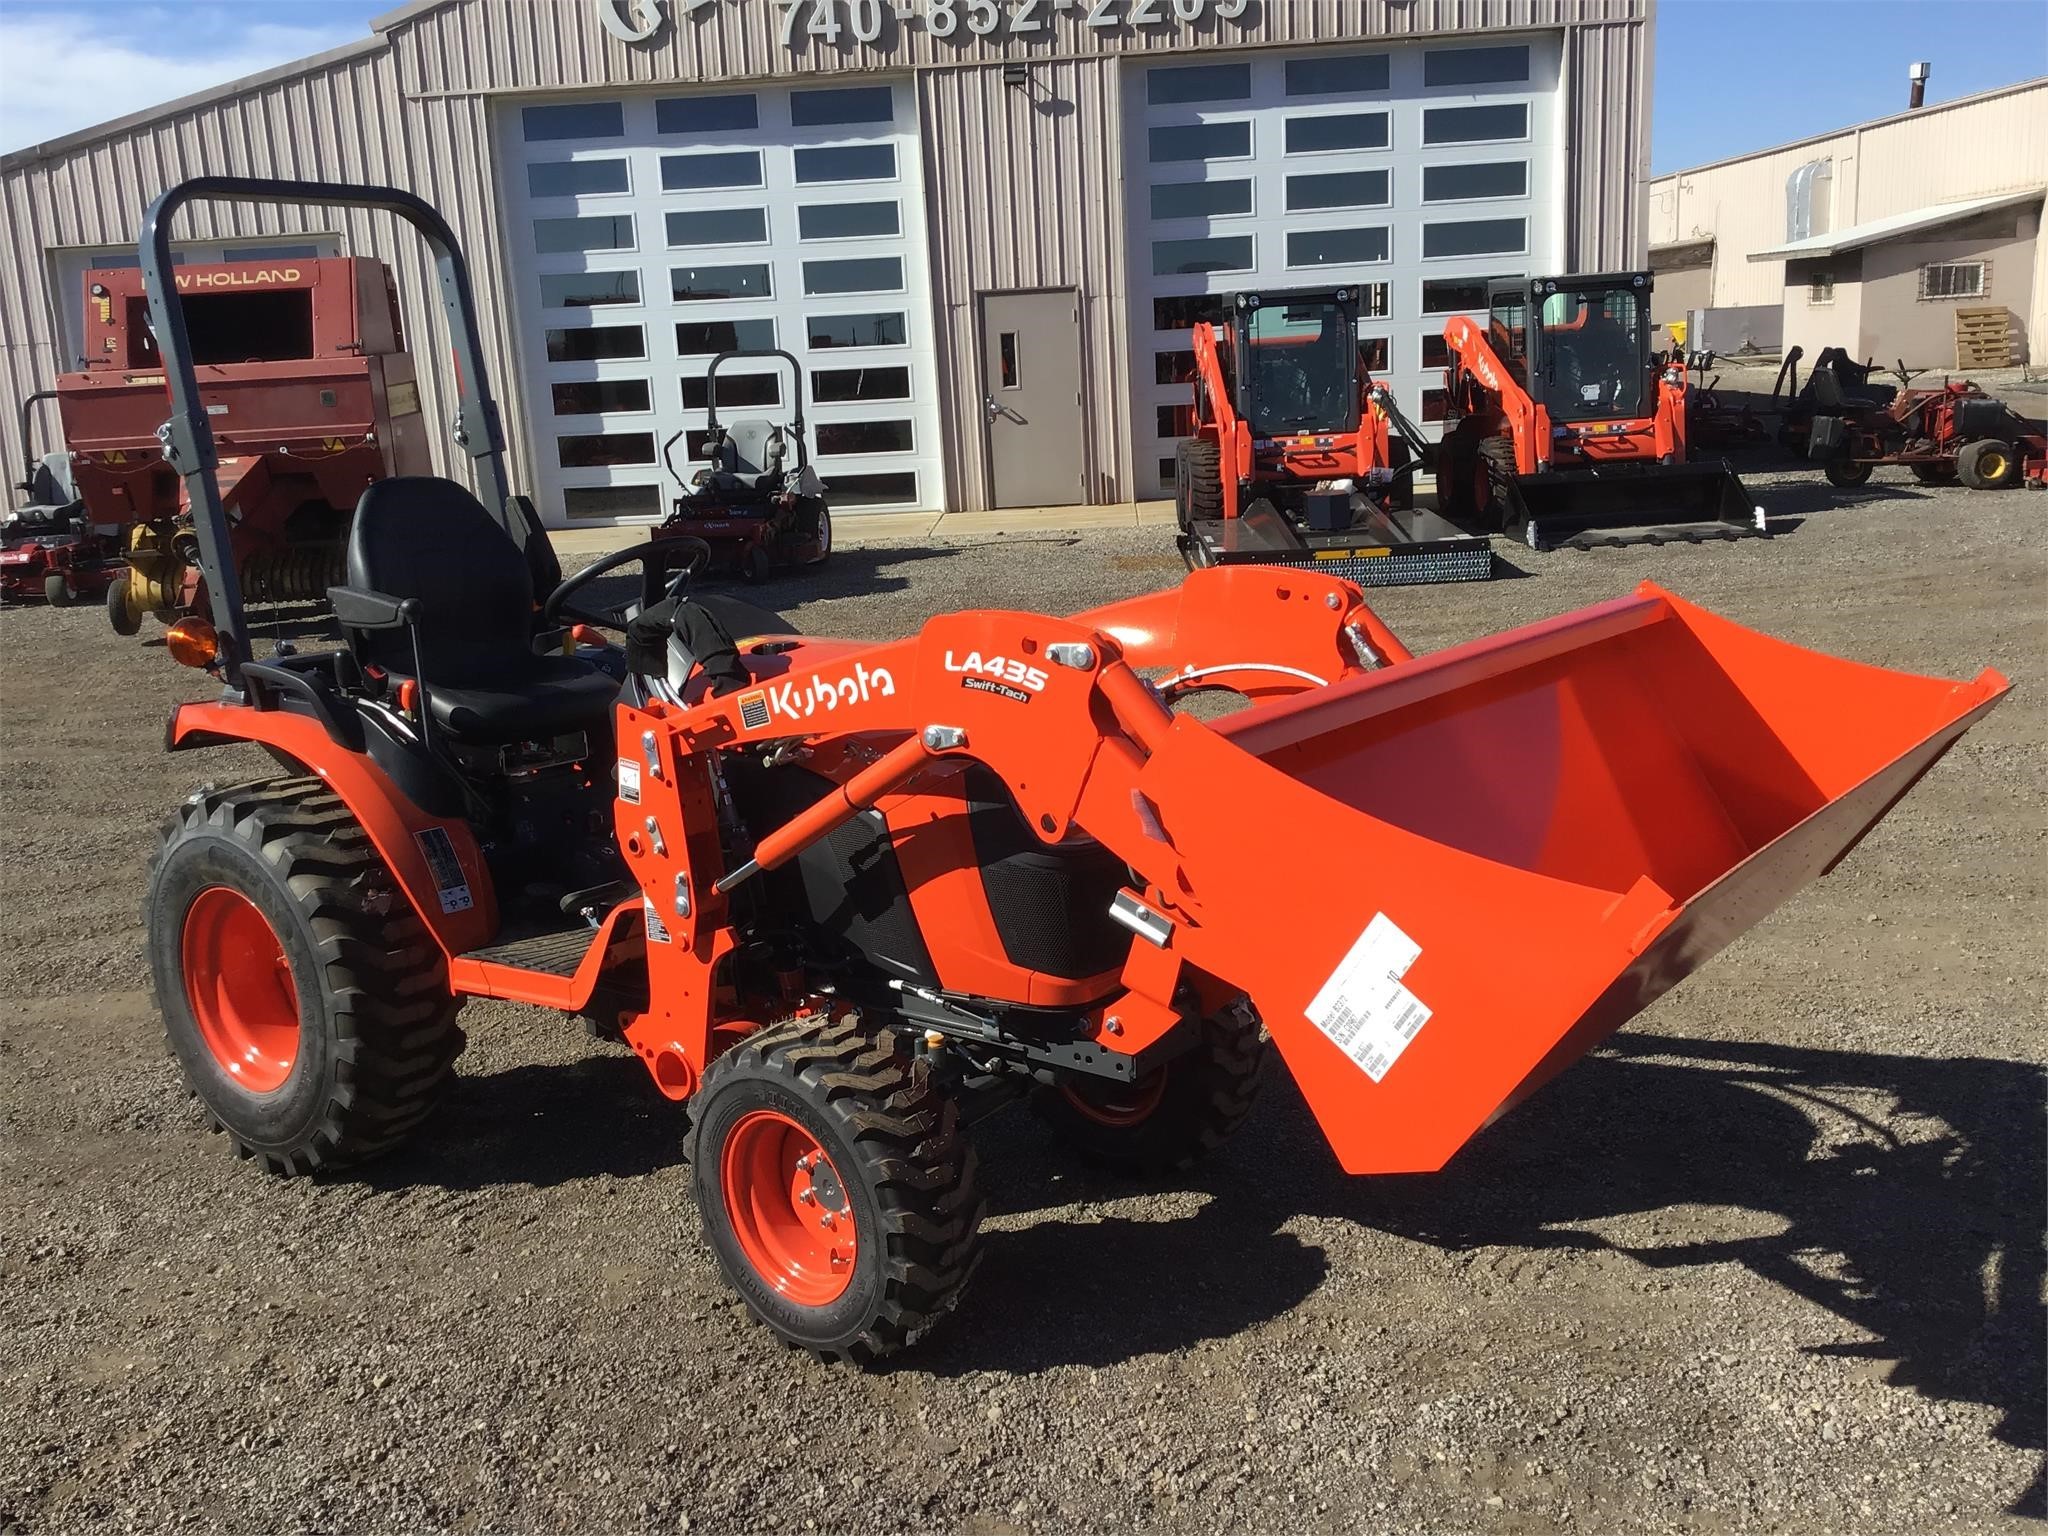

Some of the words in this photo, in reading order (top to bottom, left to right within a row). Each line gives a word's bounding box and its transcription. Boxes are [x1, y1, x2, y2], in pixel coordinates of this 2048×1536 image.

[197, 269, 301, 287] HOLLAND
[944, 650, 1049, 692] LA435
[769, 662, 895, 720] Kubota
[964, 677, 1028, 702] Swift-Tach
